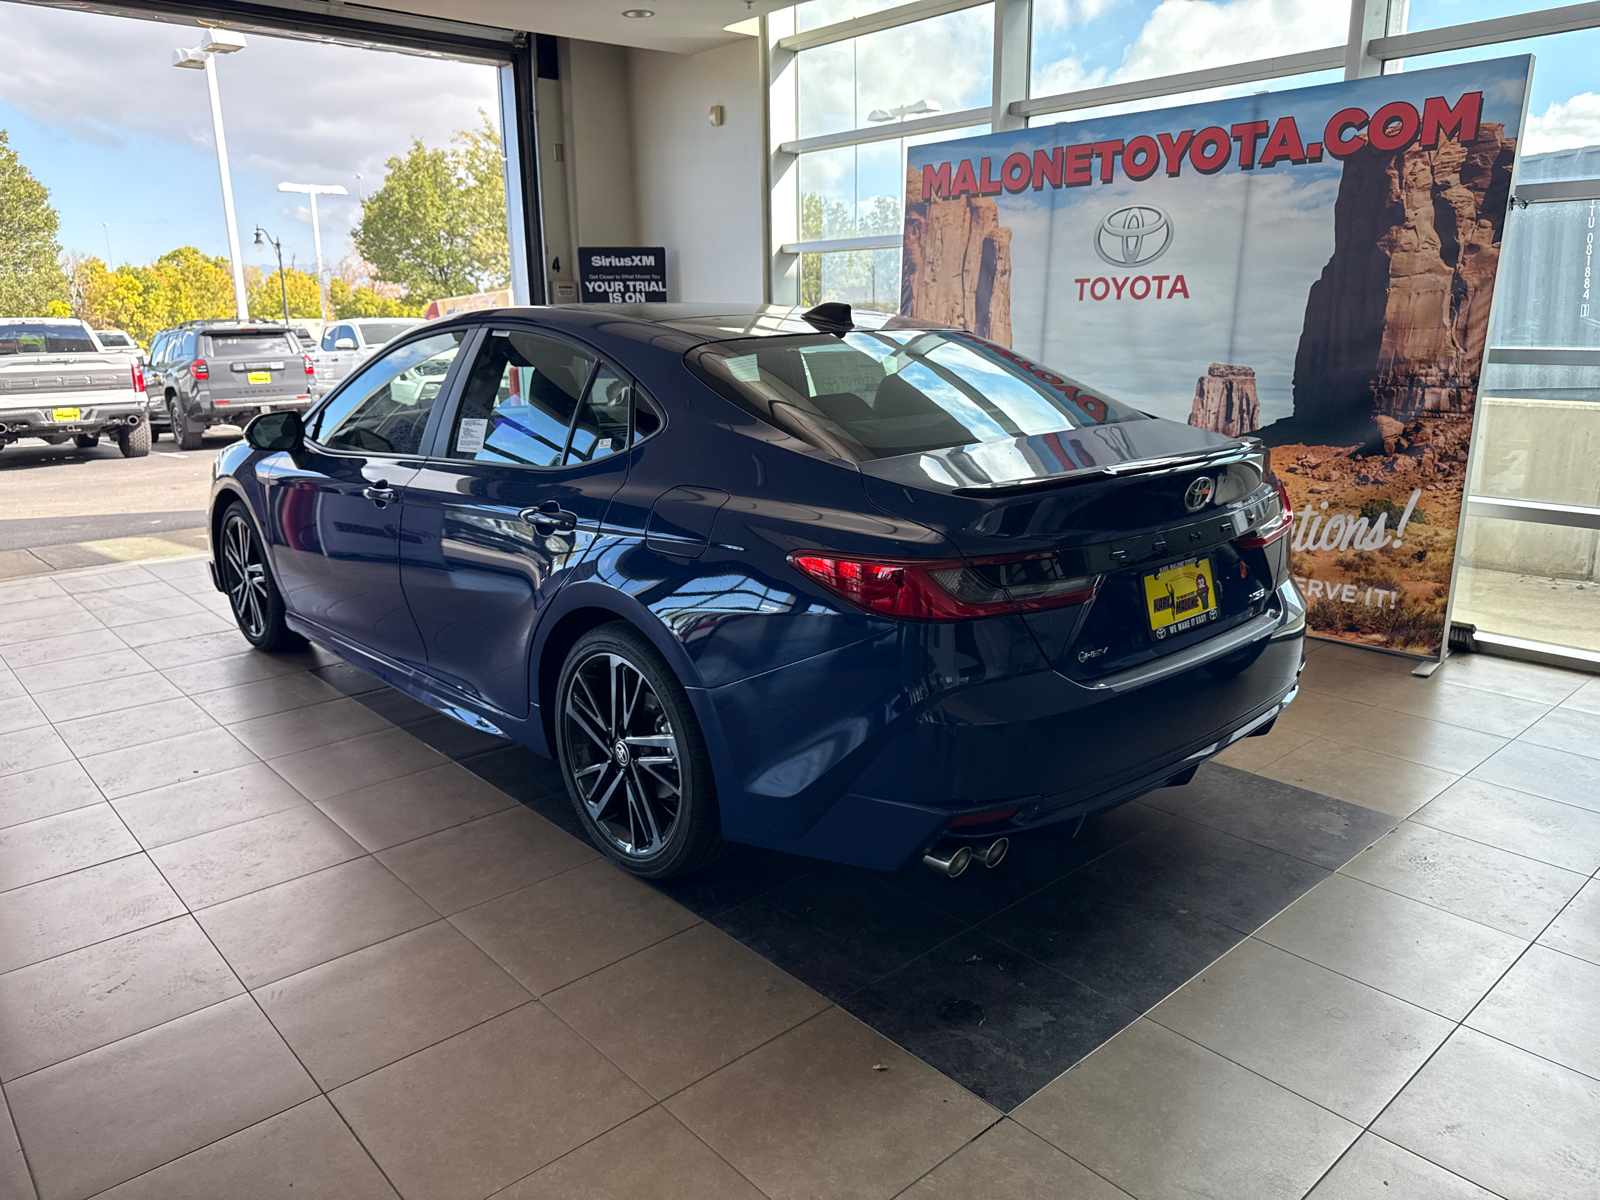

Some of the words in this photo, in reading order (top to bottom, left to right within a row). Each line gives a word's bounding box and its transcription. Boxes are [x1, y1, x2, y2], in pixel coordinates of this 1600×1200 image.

[922, 91, 1484, 204] MALONETOYOTA.COM
[552, 256, 561, 273] 4
[591, 255, 656, 267] SiriusXM
[1583, 232, 1594, 300] 081884
[585, 281, 625, 293] YOUR
[627, 281, 667, 292] TRIAL
[1074, 274, 1190, 302] TOYOTA
[609, 293, 622, 304] IS
[625, 293, 646, 303] ON
[1291, 488, 1422, 552] tions!
[1197, 578, 1205, 588] 32
[1365, 587, 1397, 610] IT!
[1169, 625, 1178, 634] WE
[1178, 620, 1191, 631] MAKE
[1196, 614, 1207, 624] EASY
